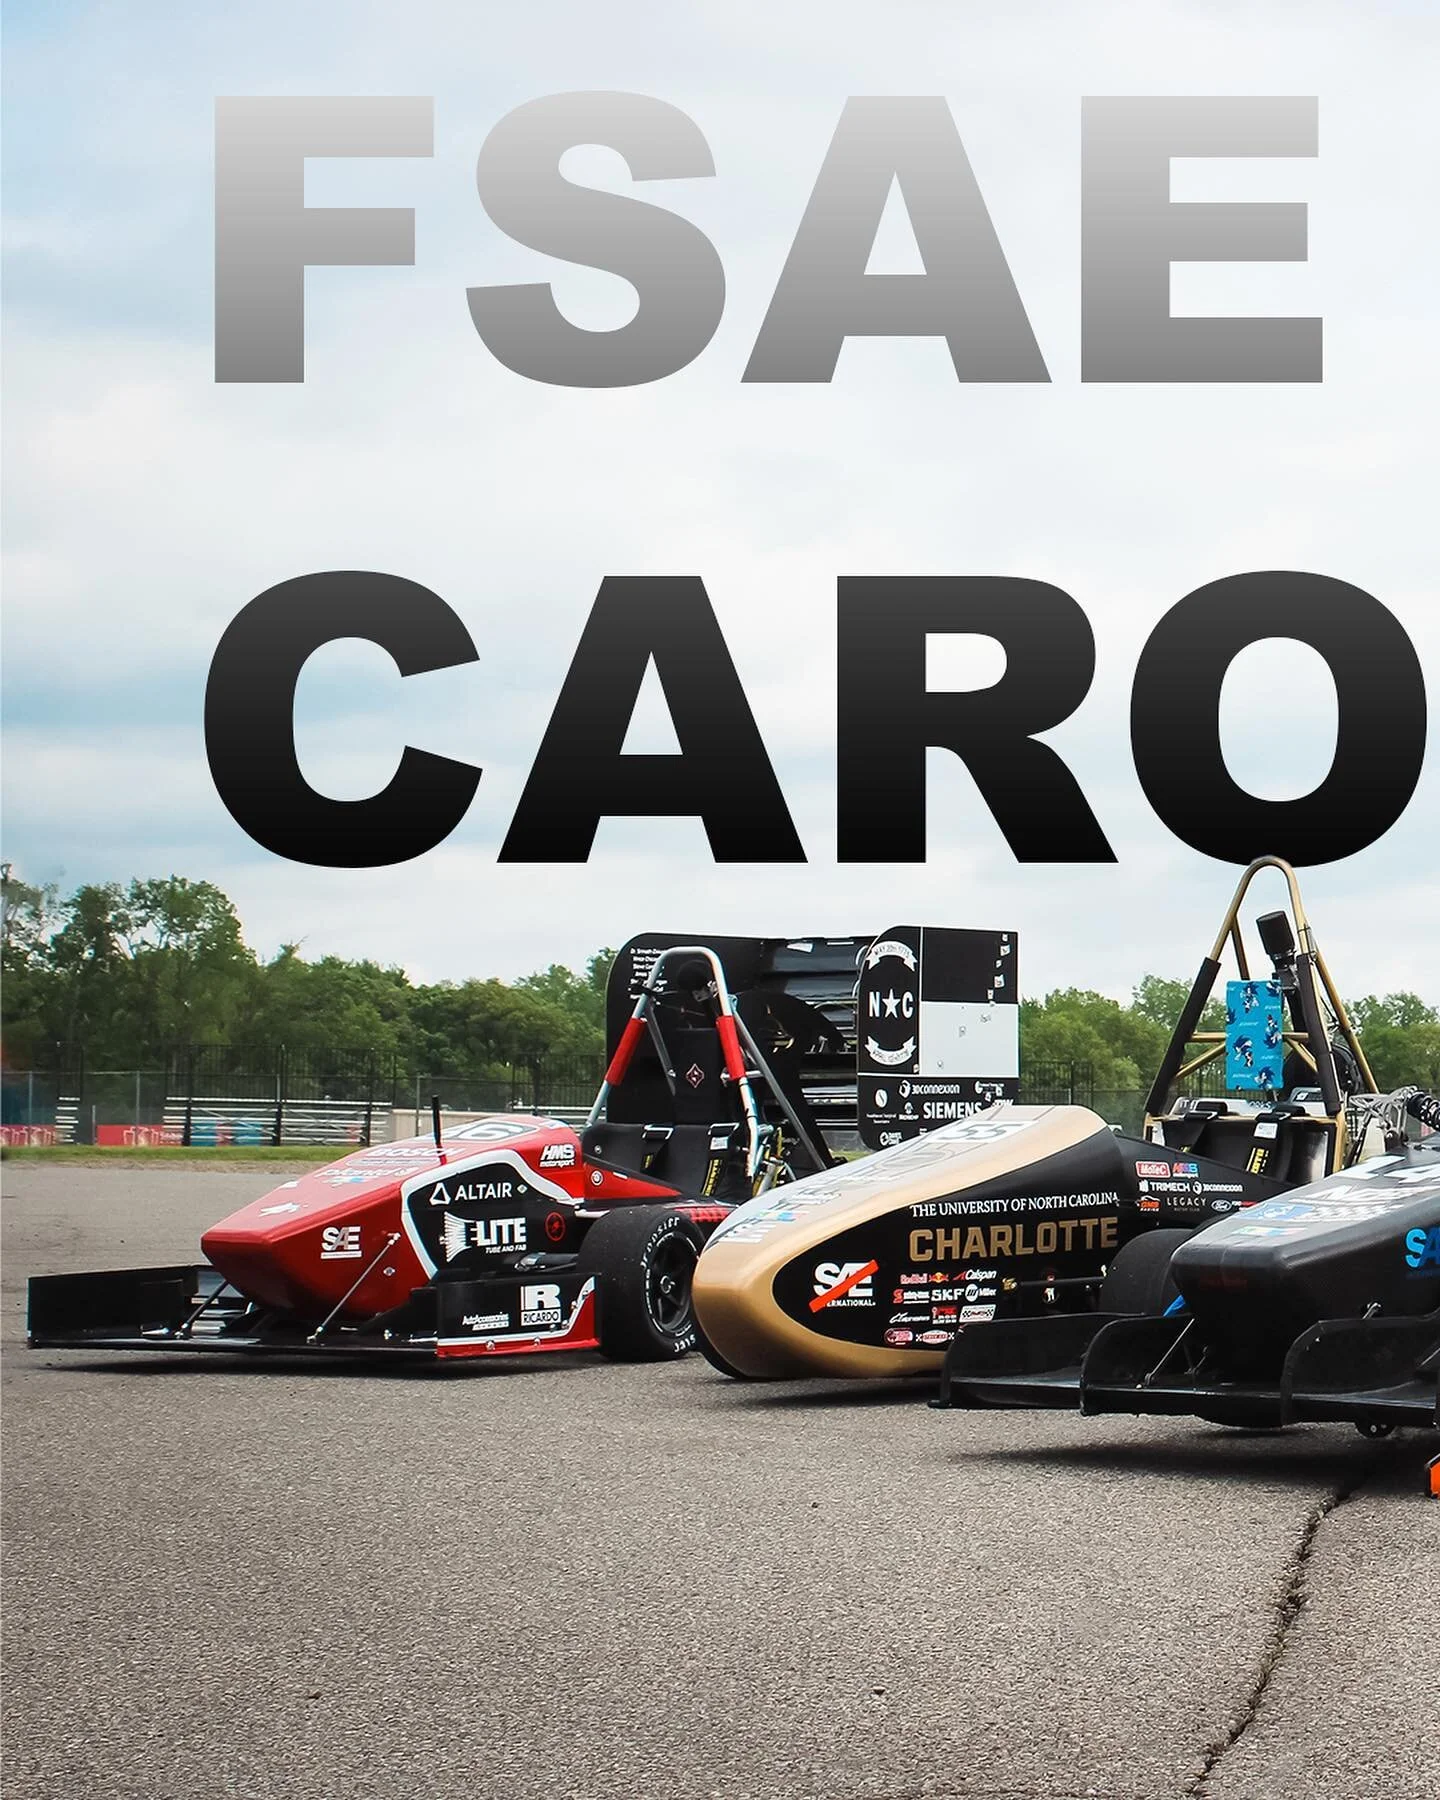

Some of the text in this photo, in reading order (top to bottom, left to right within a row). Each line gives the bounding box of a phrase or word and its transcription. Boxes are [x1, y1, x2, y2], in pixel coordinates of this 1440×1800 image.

[869, 991, 914, 1019] N C
[923, 1102, 982, 1119] SIEMENS
[540, 1144, 575, 1161] HMS
[455, 1183, 513, 1201] ALTAIR
[1150, 1182, 1191, 1192] TRIMECH
[910, 1191, 1119, 1218] THE UNIVERSITY OF NORTH CAROLINA
[1166, 1197, 1207, 1207] LEGACY
[322, 1226, 361, 1251] SAE
[909, 1216, 1119, 1262] CHARLOTTE
[965, 1268, 997, 1282] Calspan
[931, 1289, 964, 1301] SKF
[523, 1311, 560, 1323] RICARDO
